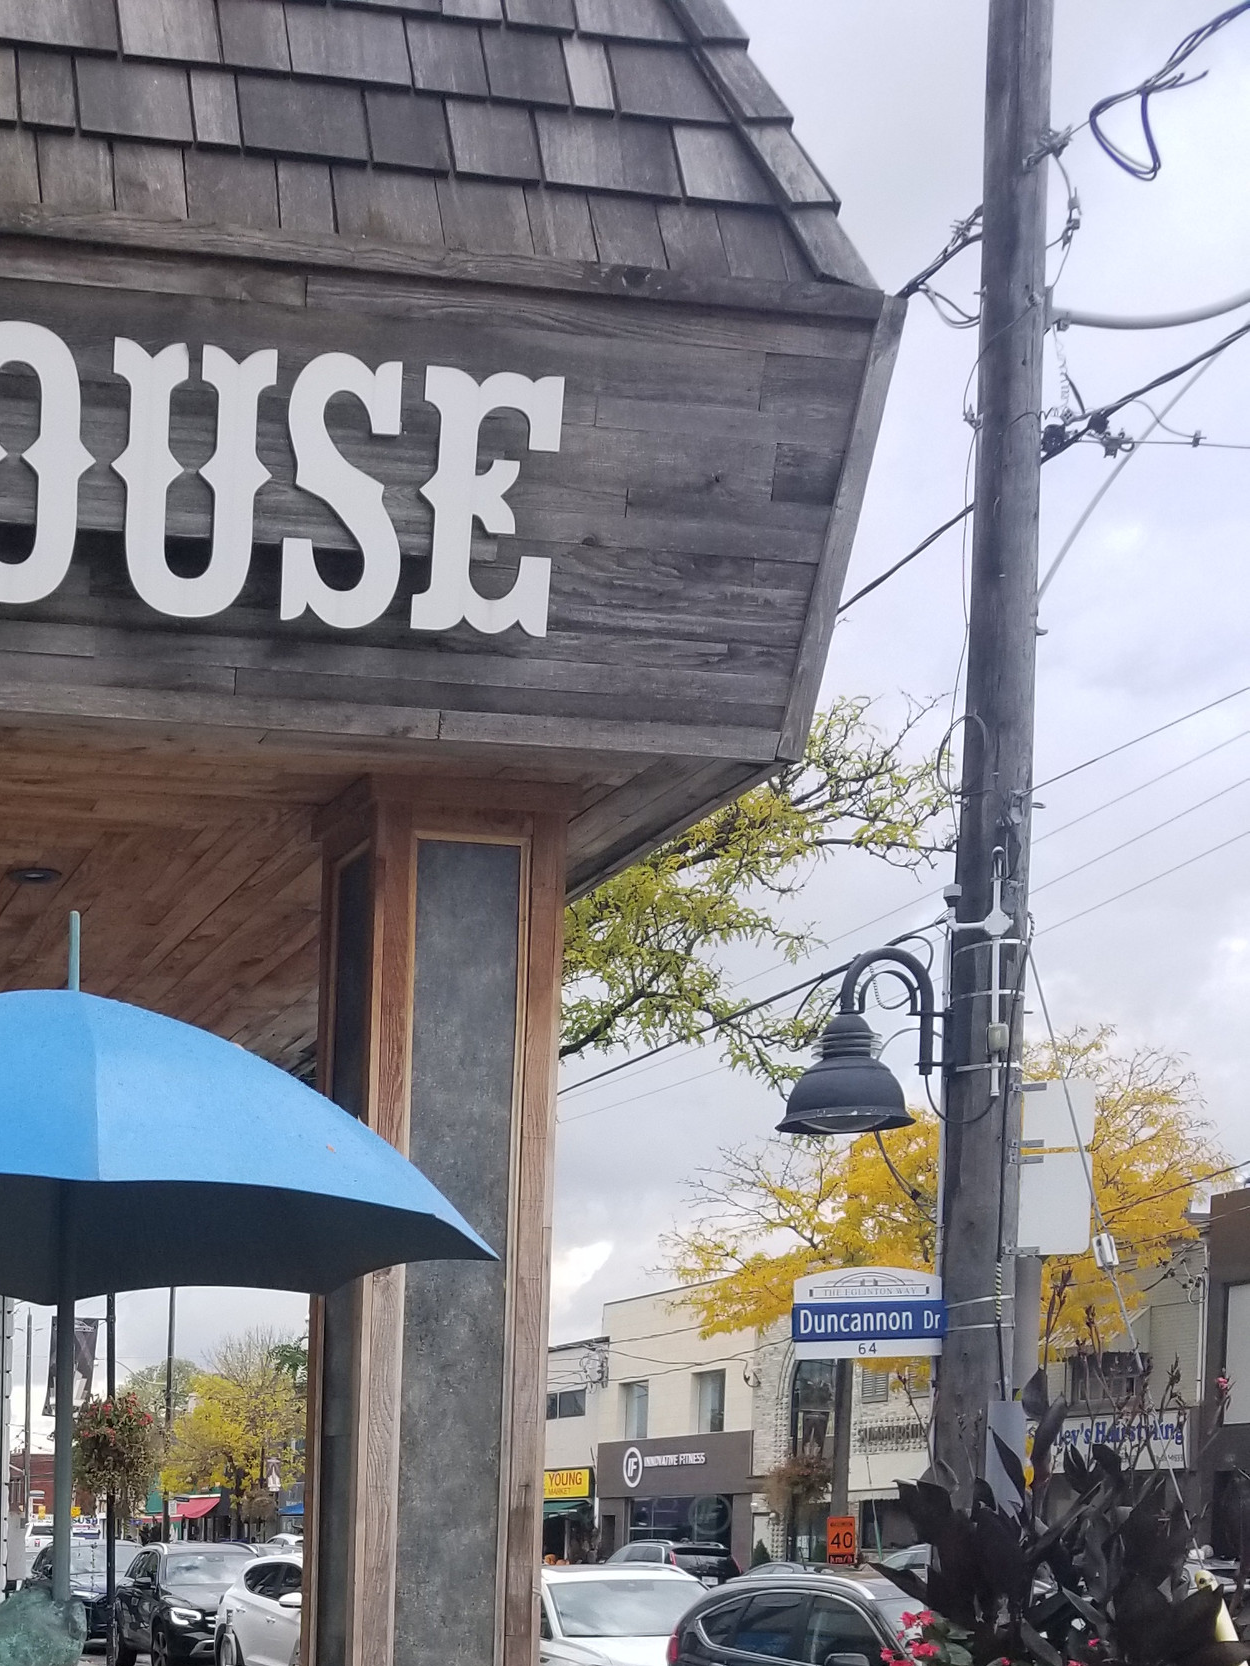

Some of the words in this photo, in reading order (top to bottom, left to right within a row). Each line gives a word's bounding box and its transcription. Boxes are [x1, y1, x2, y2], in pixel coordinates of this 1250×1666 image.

[824, 1288, 839, 1297] THE
[845, 1287, 893, 1297] EGLINTON
[895, 1286, 917, 1295] WAY
[800, 1309, 913, 1334] Duncannon
[923, 1310, 941, 1329] Dr
[858, 1342, 877, 1355] 64
[679, 1452, 706, 1466] FITNESS
[549, 1471, 582, 1487] YOUNG
[549, 1487, 571, 1496] MARKET
[830, 1531, 853, 1549] 40
[830, 1555, 853, 1564] km/h
